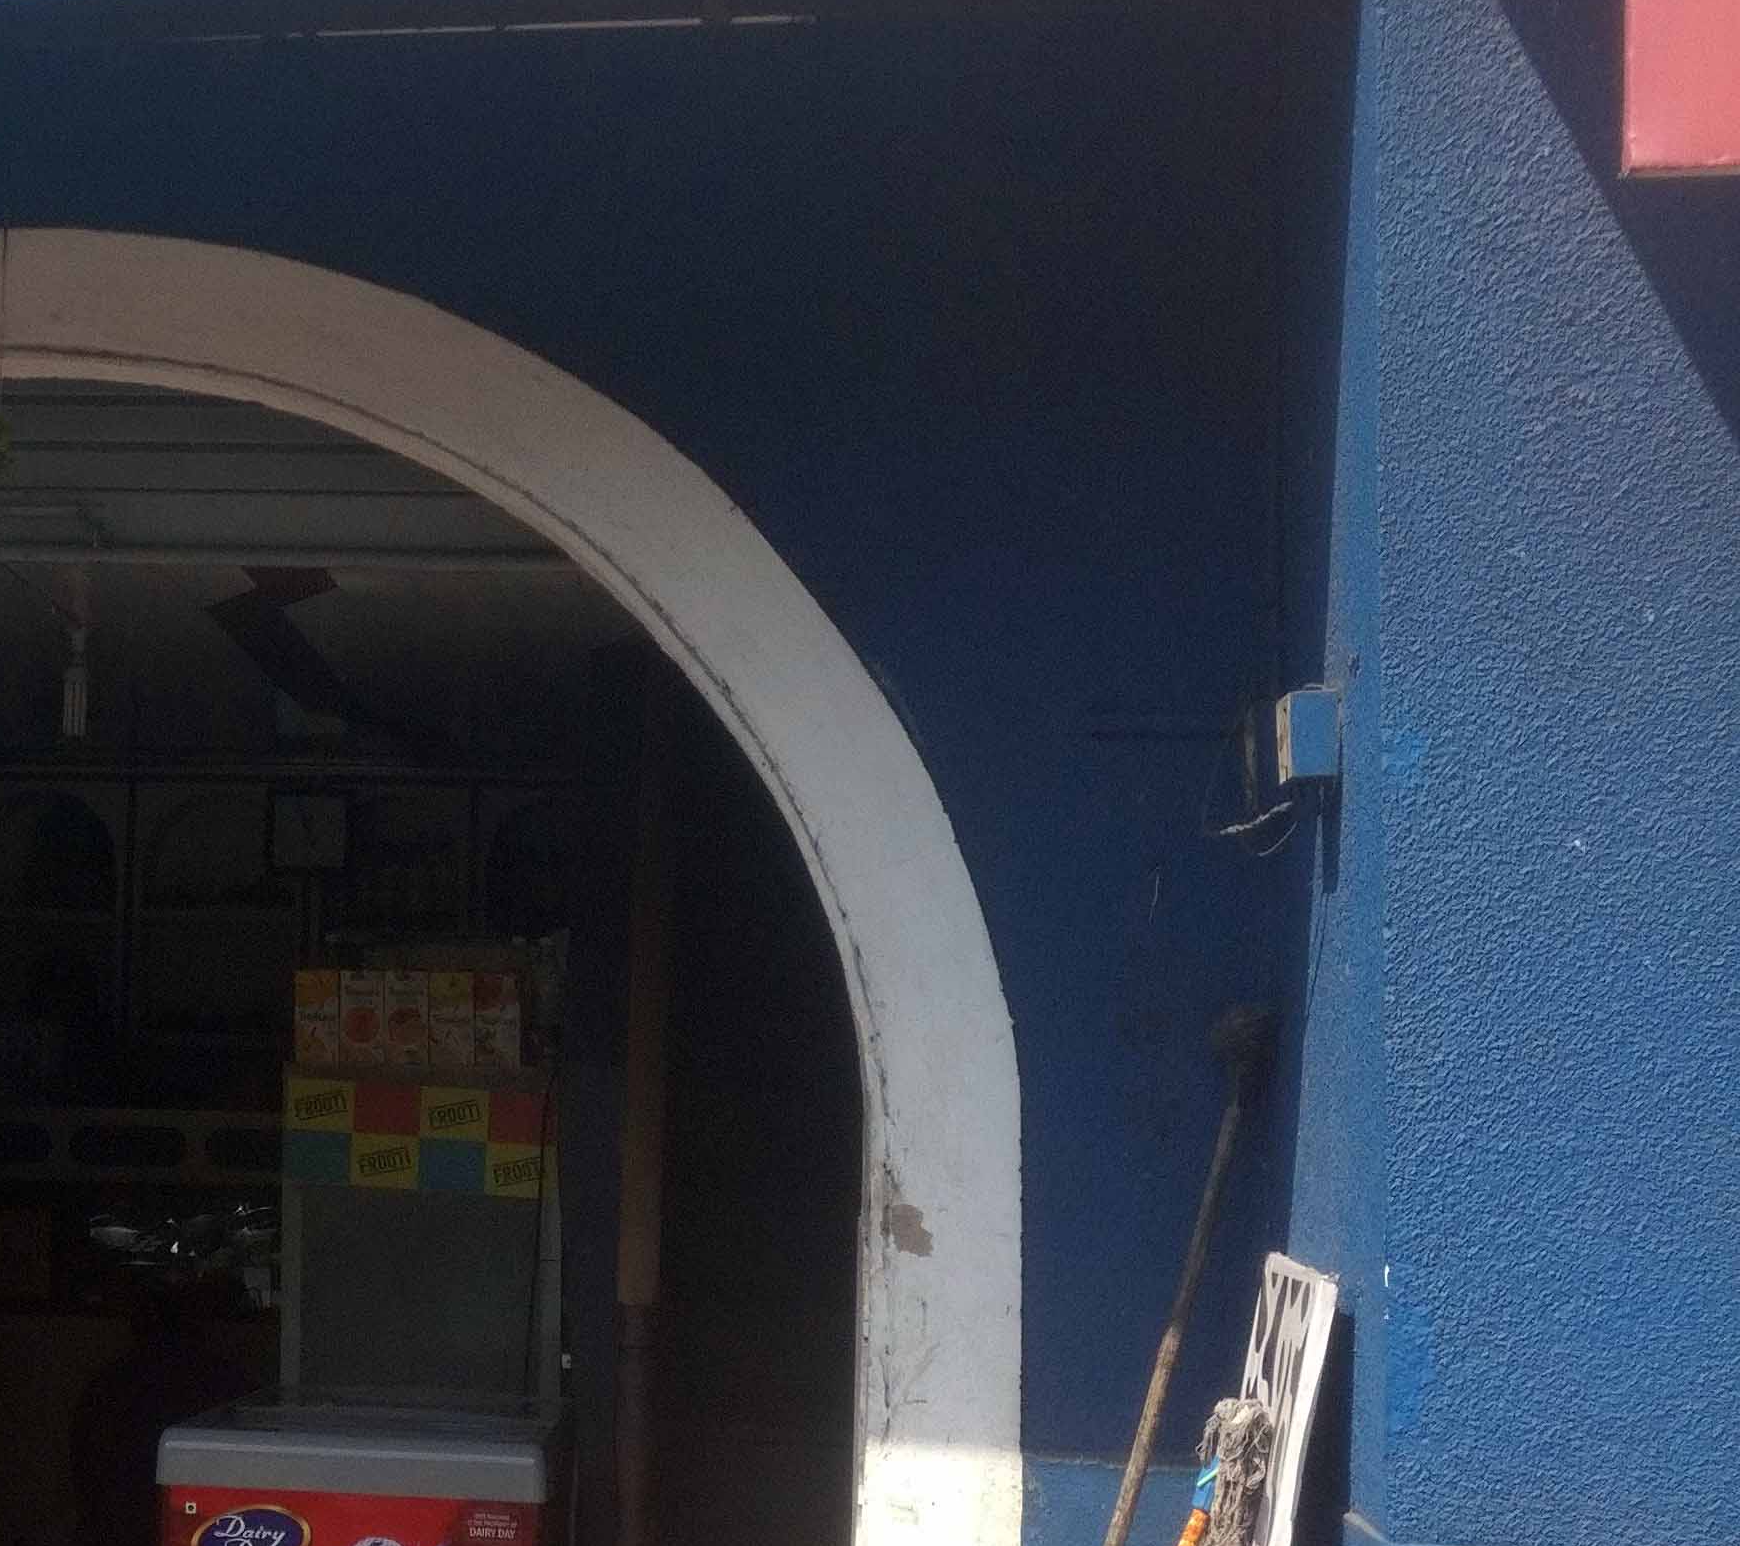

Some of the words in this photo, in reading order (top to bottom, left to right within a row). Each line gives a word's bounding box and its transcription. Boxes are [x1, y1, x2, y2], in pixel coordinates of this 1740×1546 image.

[429, 1103, 481, 1128] FROOTI
[358, 1148, 412, 1174] FROOTI
[469, 1526, 496, 1538] DAIRY
[497, 1527, 516, 1539] DAY
